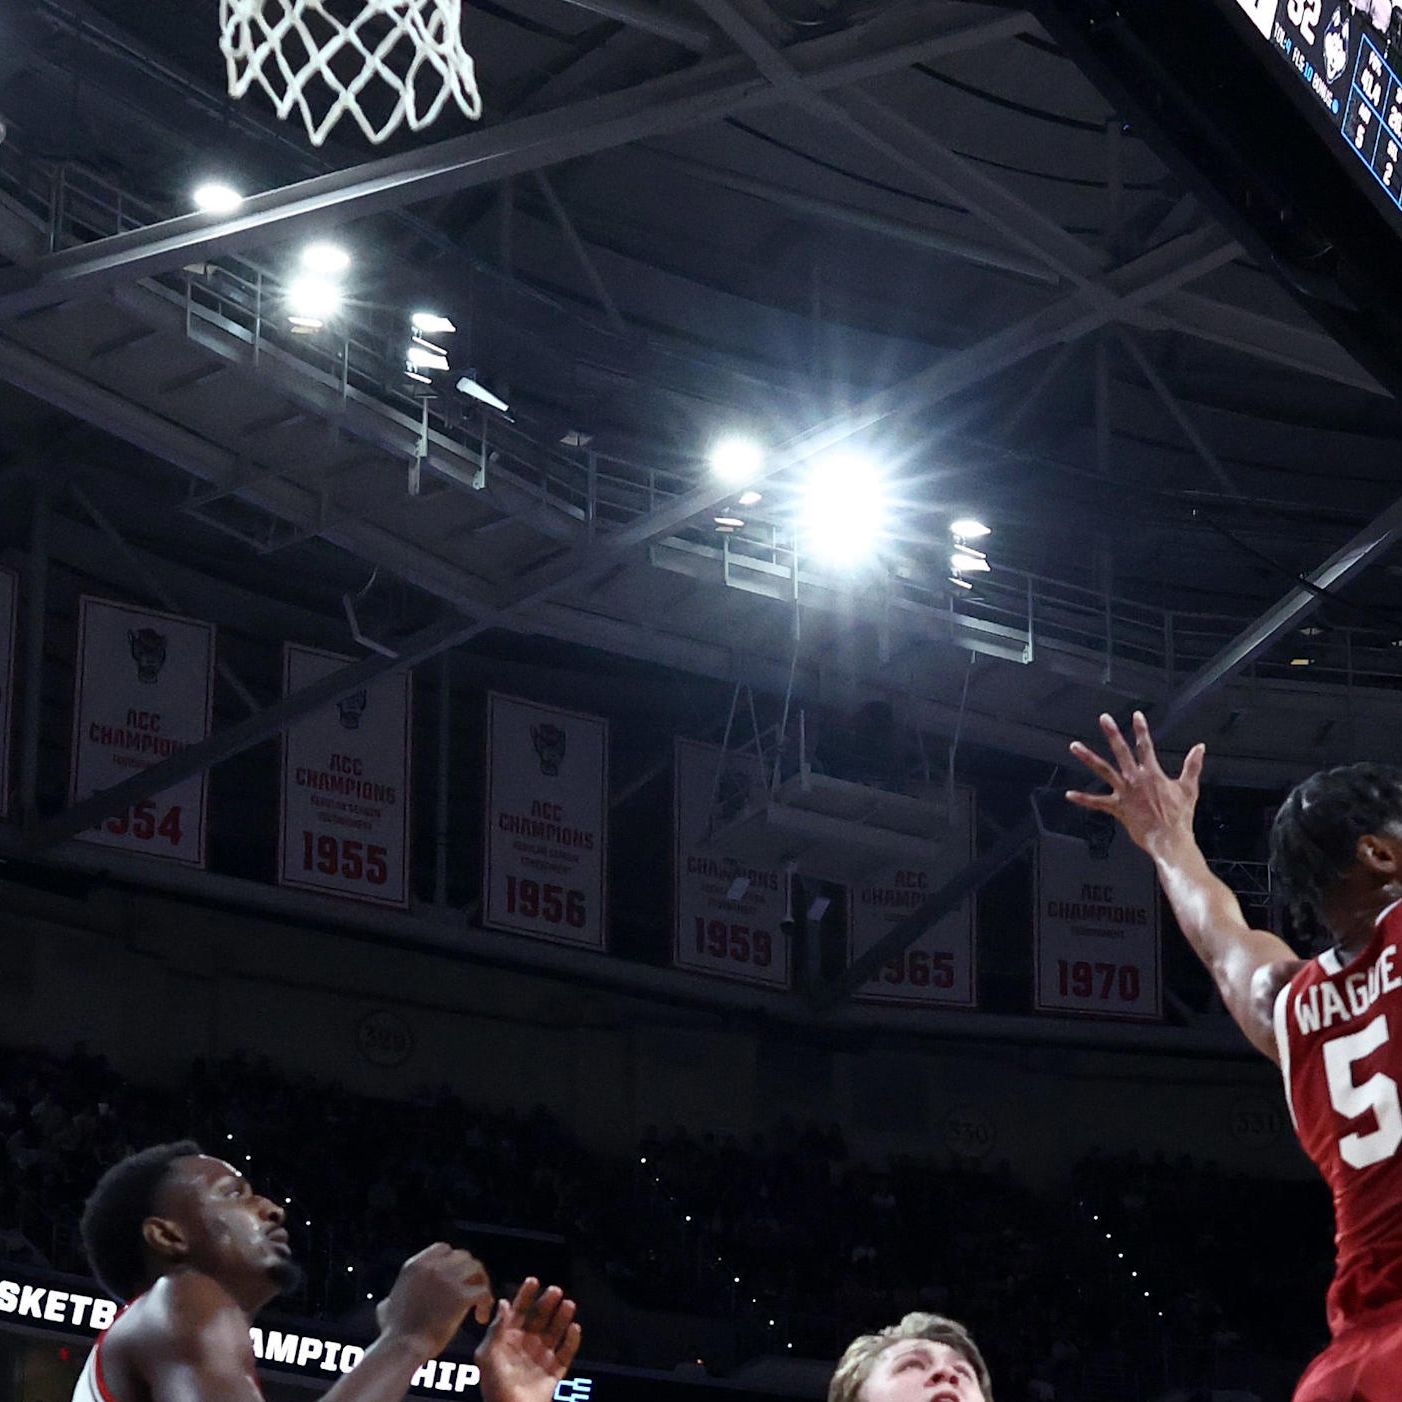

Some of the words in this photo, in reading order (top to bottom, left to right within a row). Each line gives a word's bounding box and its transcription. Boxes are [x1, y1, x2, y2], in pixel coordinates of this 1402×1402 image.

[126, 708, 161, 733] ACC
[89, 722, 186, 757] CHAMPION
[329, 753, 364, 777] ACC
[295, 767, 397, 806] CHAMPIONS
[106, 803, 184, 846] 954
[529, 799, 564, 823] ACC
[498, 812, 595, 852] CHAMPIONS
[302, 830, 389, 886] 1955
[893, 870, 929, 891] ACC
[1080, 881, 1115, 904] ACC
[506, 875, 587, 930] 1956
[1047, 900, 1148, 927] CHAMPIONS
[694, 916, 773, 969] 1959
[1057, 958, 1142, 1003] 1970
